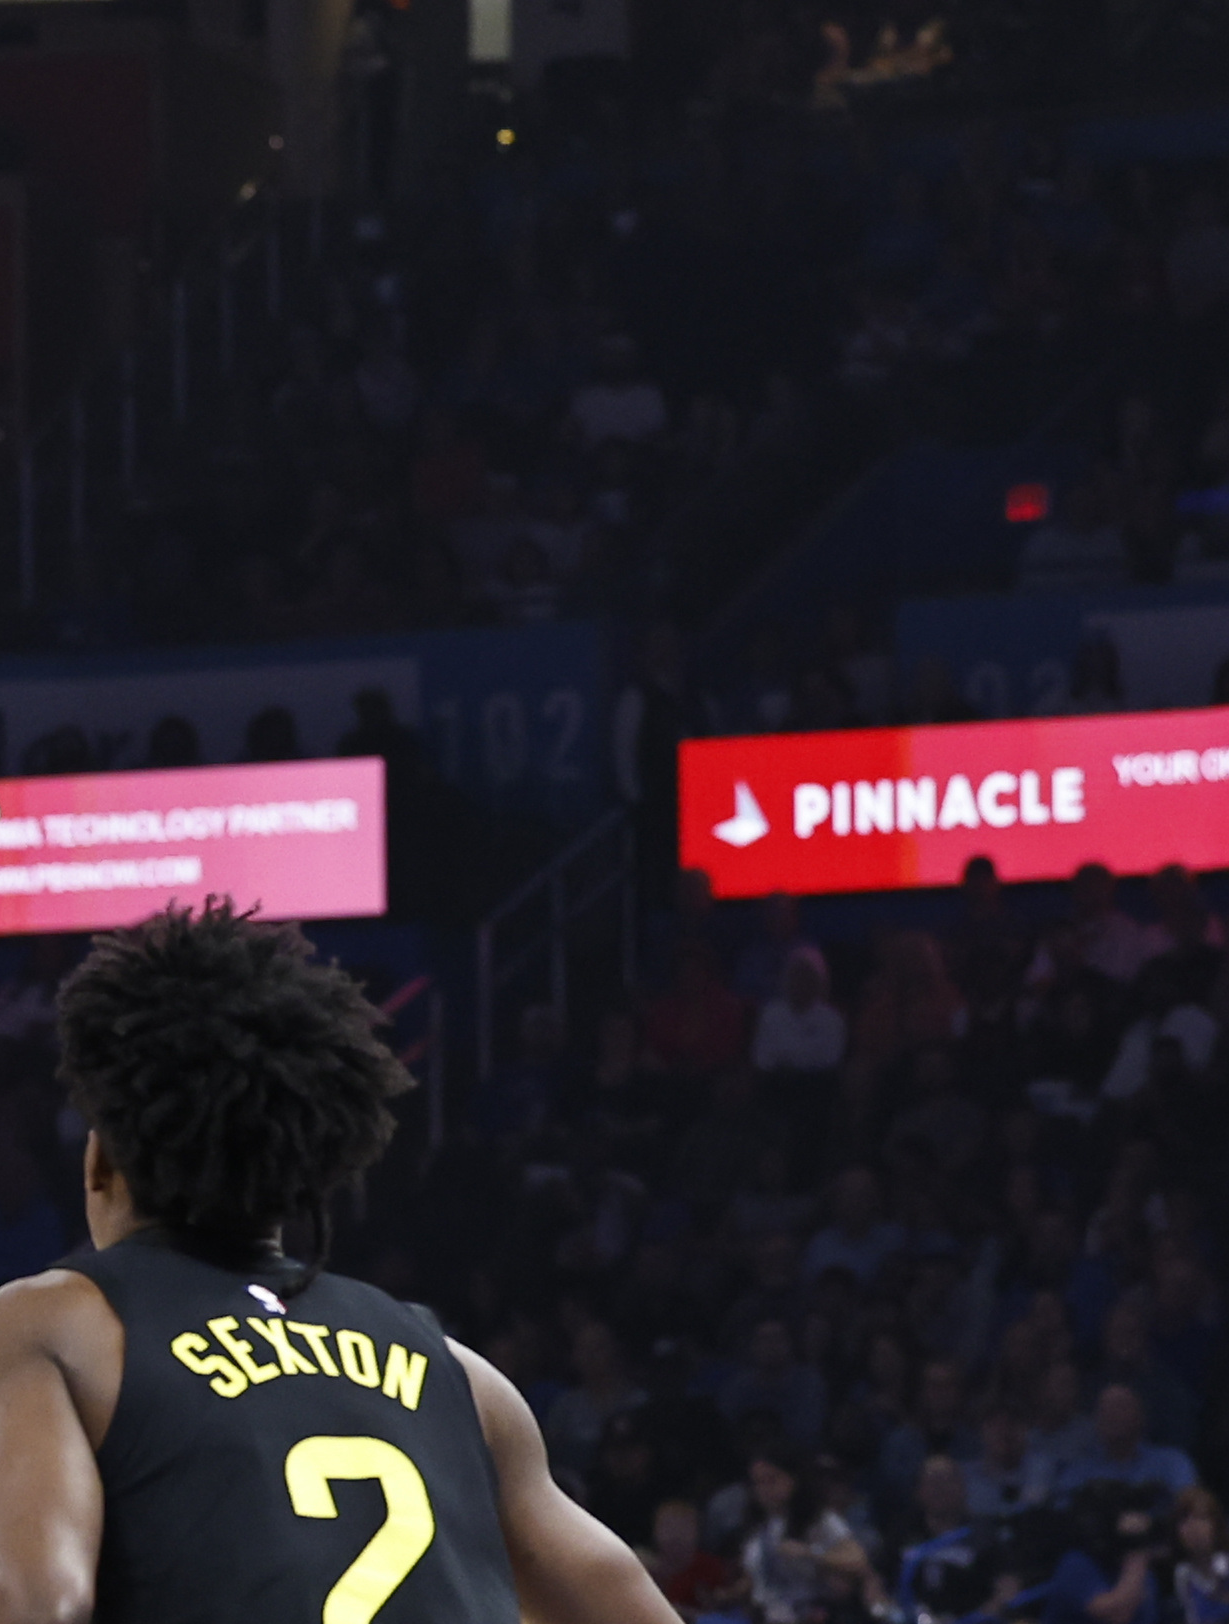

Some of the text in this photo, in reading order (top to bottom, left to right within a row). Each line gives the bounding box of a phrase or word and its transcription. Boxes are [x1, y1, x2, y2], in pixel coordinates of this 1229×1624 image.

[1112, 751, 1200, 788] YOUR
[42, 806, 227, 848] TECHNOLOGY
[227, 798, 359, 836] PARTNER
[792, 765, 1086, 840] PINNACLE
[170, 1315, 429, 1412] SEXTON
